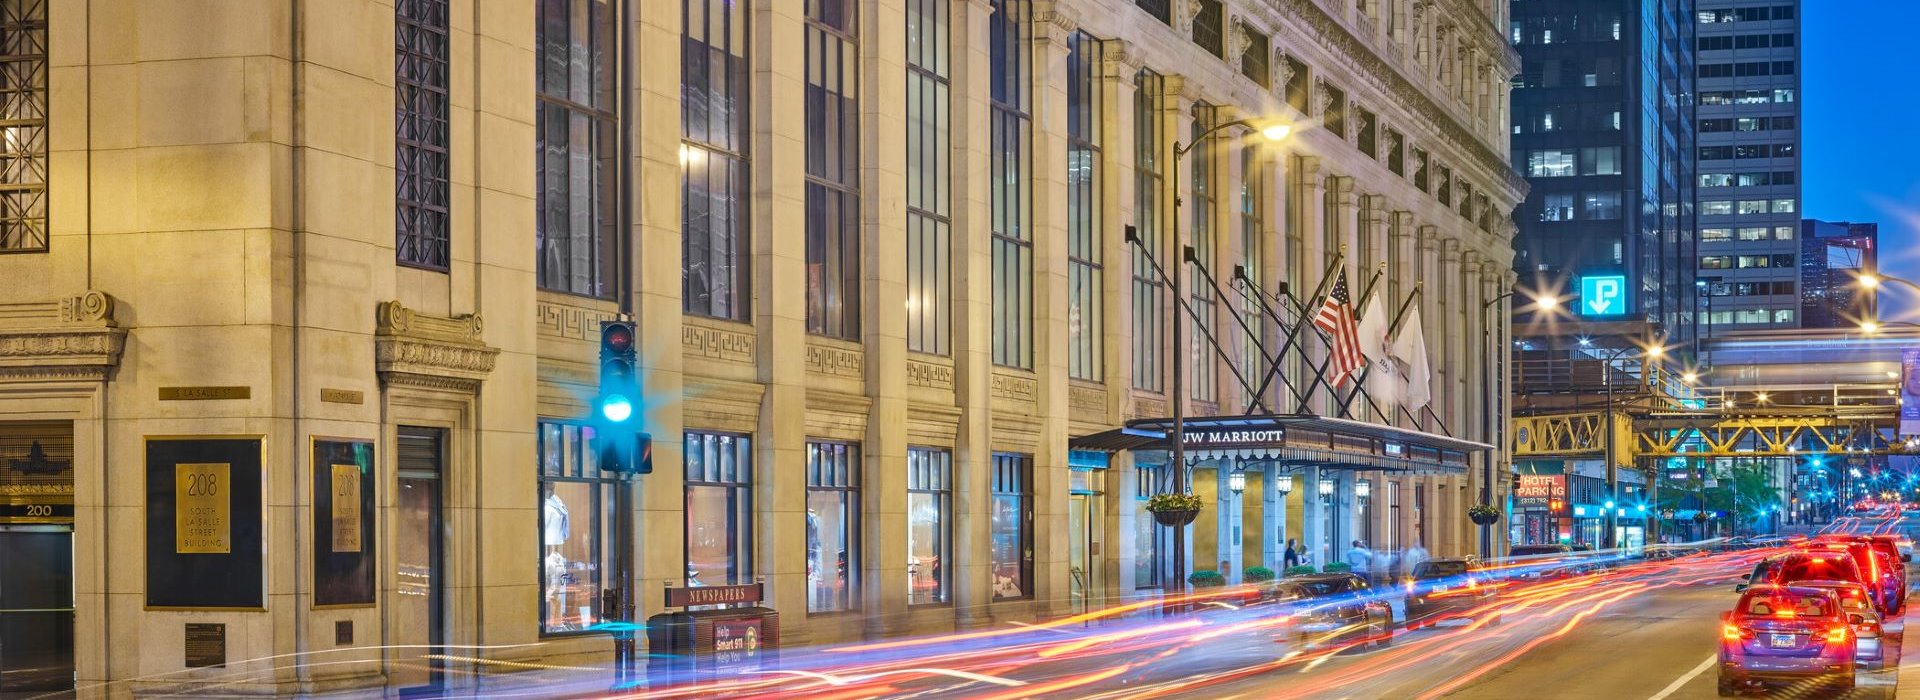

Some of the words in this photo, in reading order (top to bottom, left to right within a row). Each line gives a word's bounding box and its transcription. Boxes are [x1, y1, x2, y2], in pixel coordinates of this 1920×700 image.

[184, 389, 194, 397] LA
[197, 388, 218, 397] SALLE
[1183, 432, 1204, 443] JW
[1208, 430, 1283, 443] MARRIOTT
[188, 473, 217, 496] 208
[338, 474, 354, 496] 208
[1518, 486, 1564, 496] PARKING
[27, 504, 52, 516] 200
[190, 507, 216, 516] SOUTH
[198, 517, 220, 526] SALLE
[190, 528, 216, 537] STREET
[184, 539, 222, 547] BUILDING
[689, 587, 745, 602] NEWSPAPERS
[716, 626, 730, 639] Help
